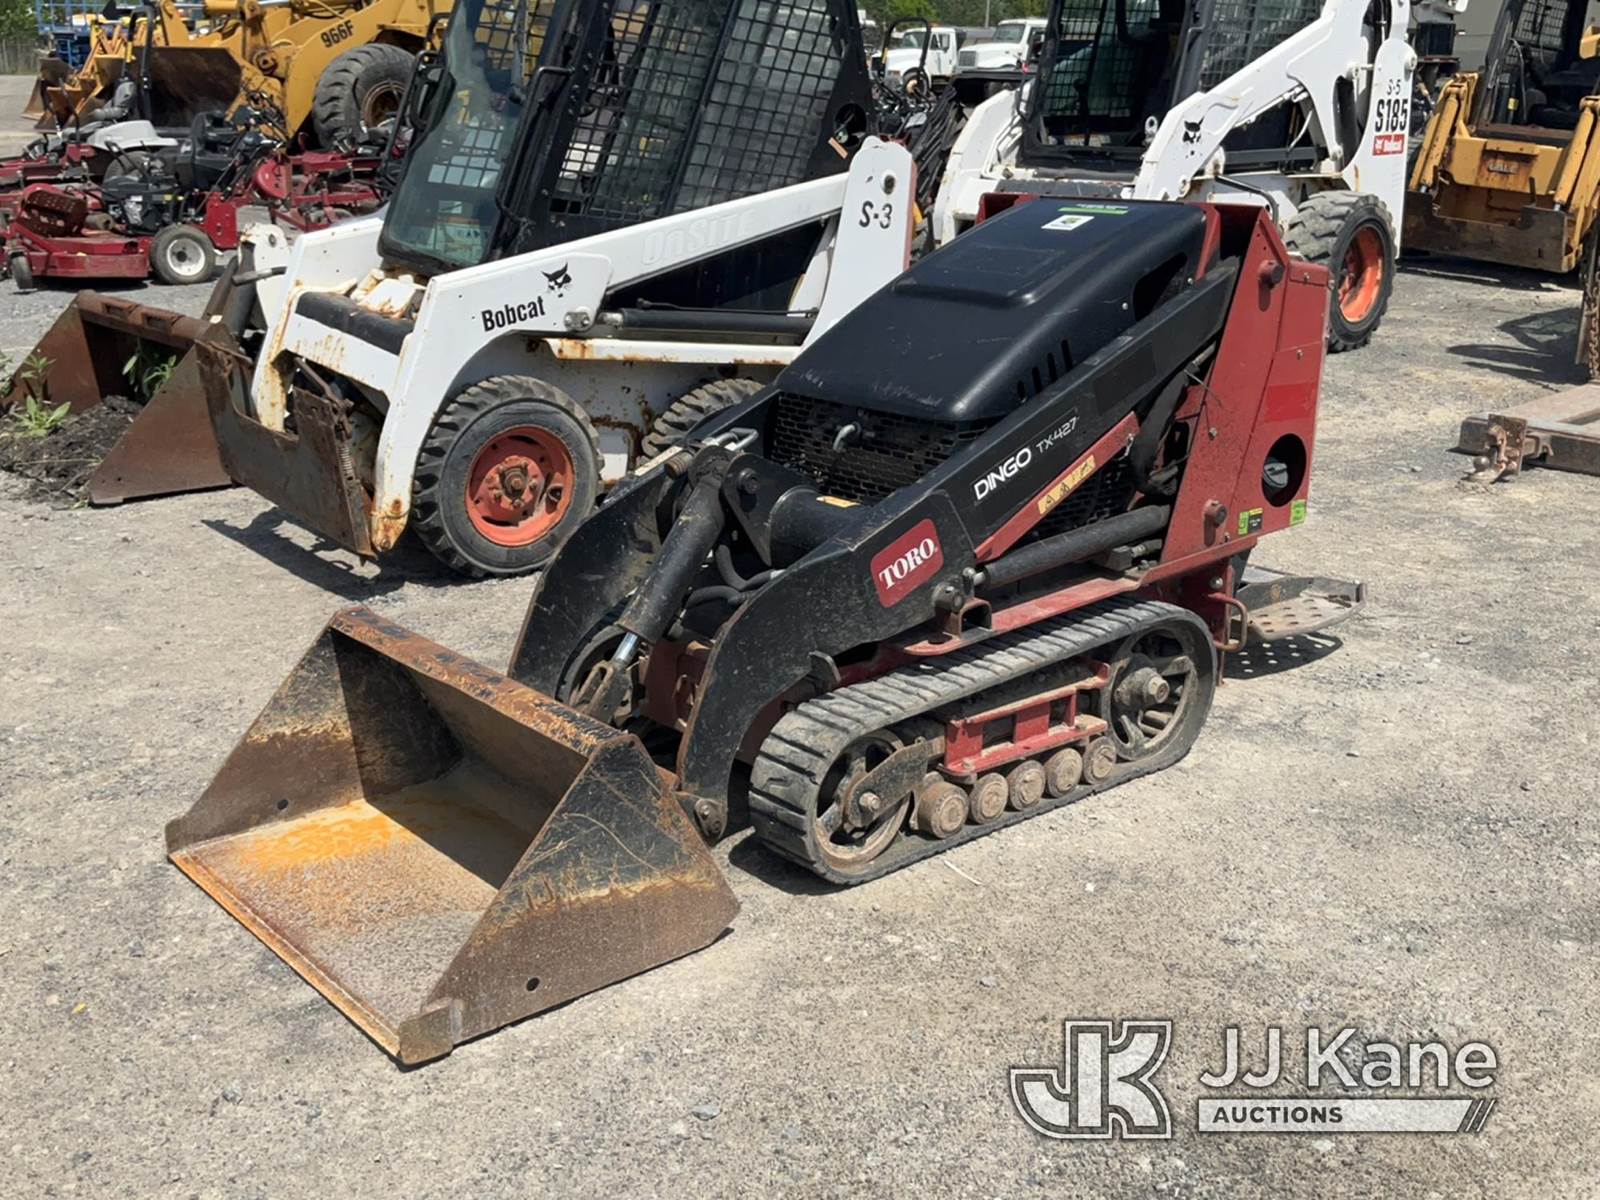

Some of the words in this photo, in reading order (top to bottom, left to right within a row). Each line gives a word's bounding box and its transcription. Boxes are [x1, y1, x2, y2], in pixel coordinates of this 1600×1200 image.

[320, 19, 354, 48] 966F
[1375, 98, 1408, 132] S185
[858, 200, 893, 229] S-3
[481, 295, 546, 332] Bobcat
[973, 447, 1032, 500] DINGO
[878, 538, 935, 590] TORO
